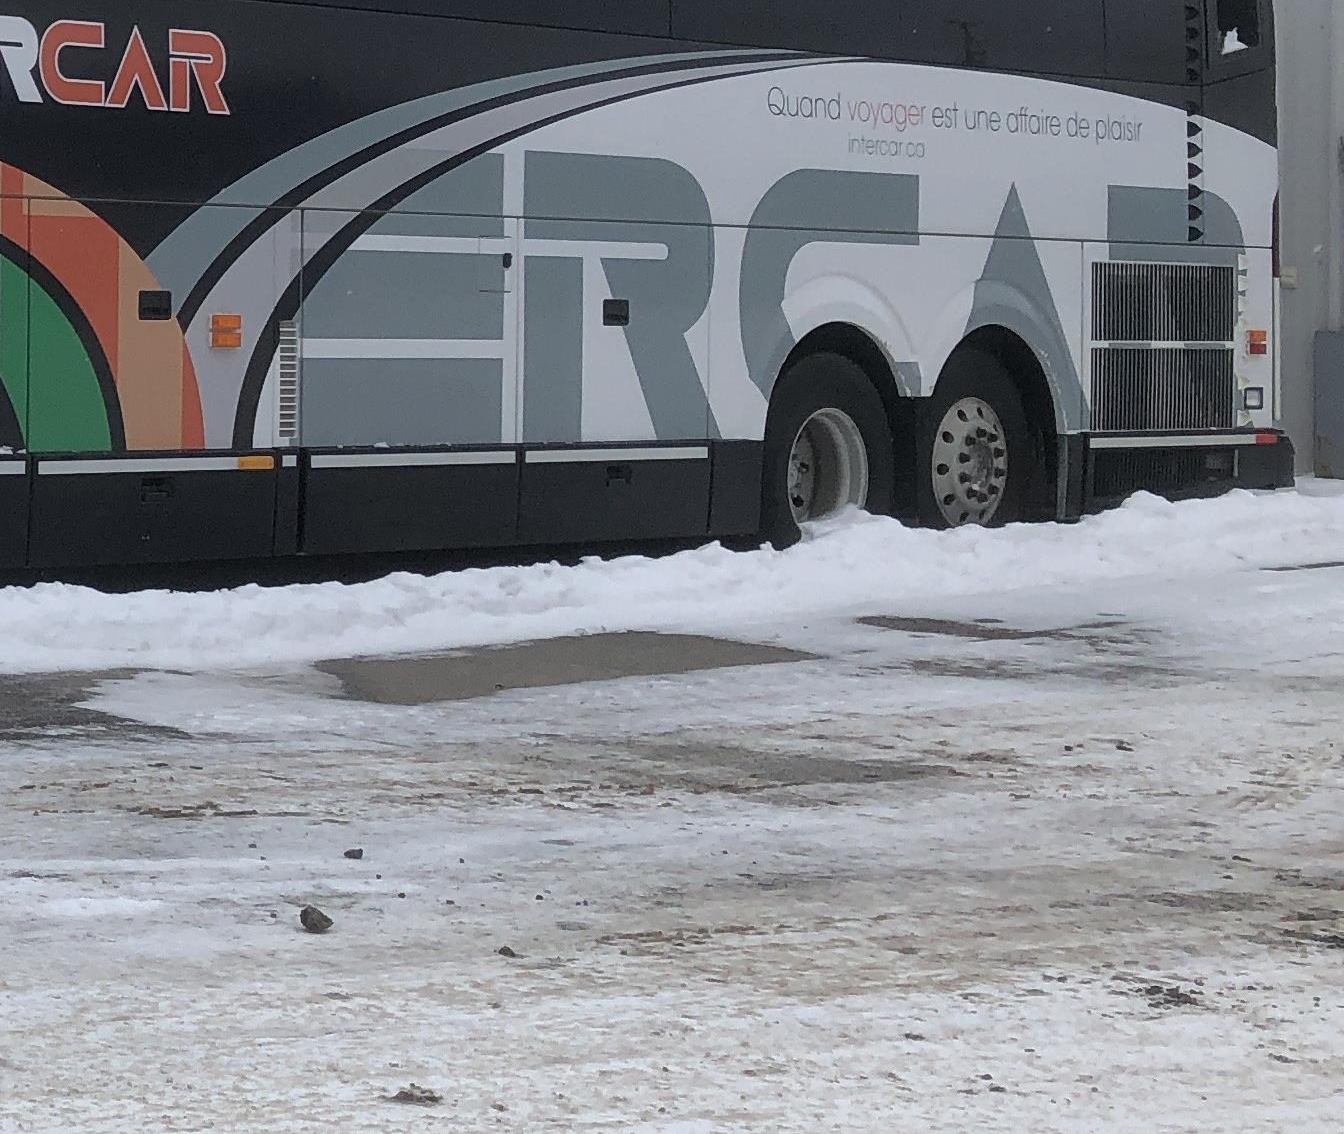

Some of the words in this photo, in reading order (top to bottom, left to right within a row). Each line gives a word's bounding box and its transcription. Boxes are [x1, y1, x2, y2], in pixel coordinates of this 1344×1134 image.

[768, 87, 840, 120] Quand
[848, 101, 926, 132] voyager
[932, 102, 958, 128] est
[965, 111, 1001, 131] une
[1006, 107, 1061, 136] affaire
[1067, 113, 1090, 138] de
[1096, 116, 1142, 145] plaisir
[849, 137, 925, 158] intercar.ca
